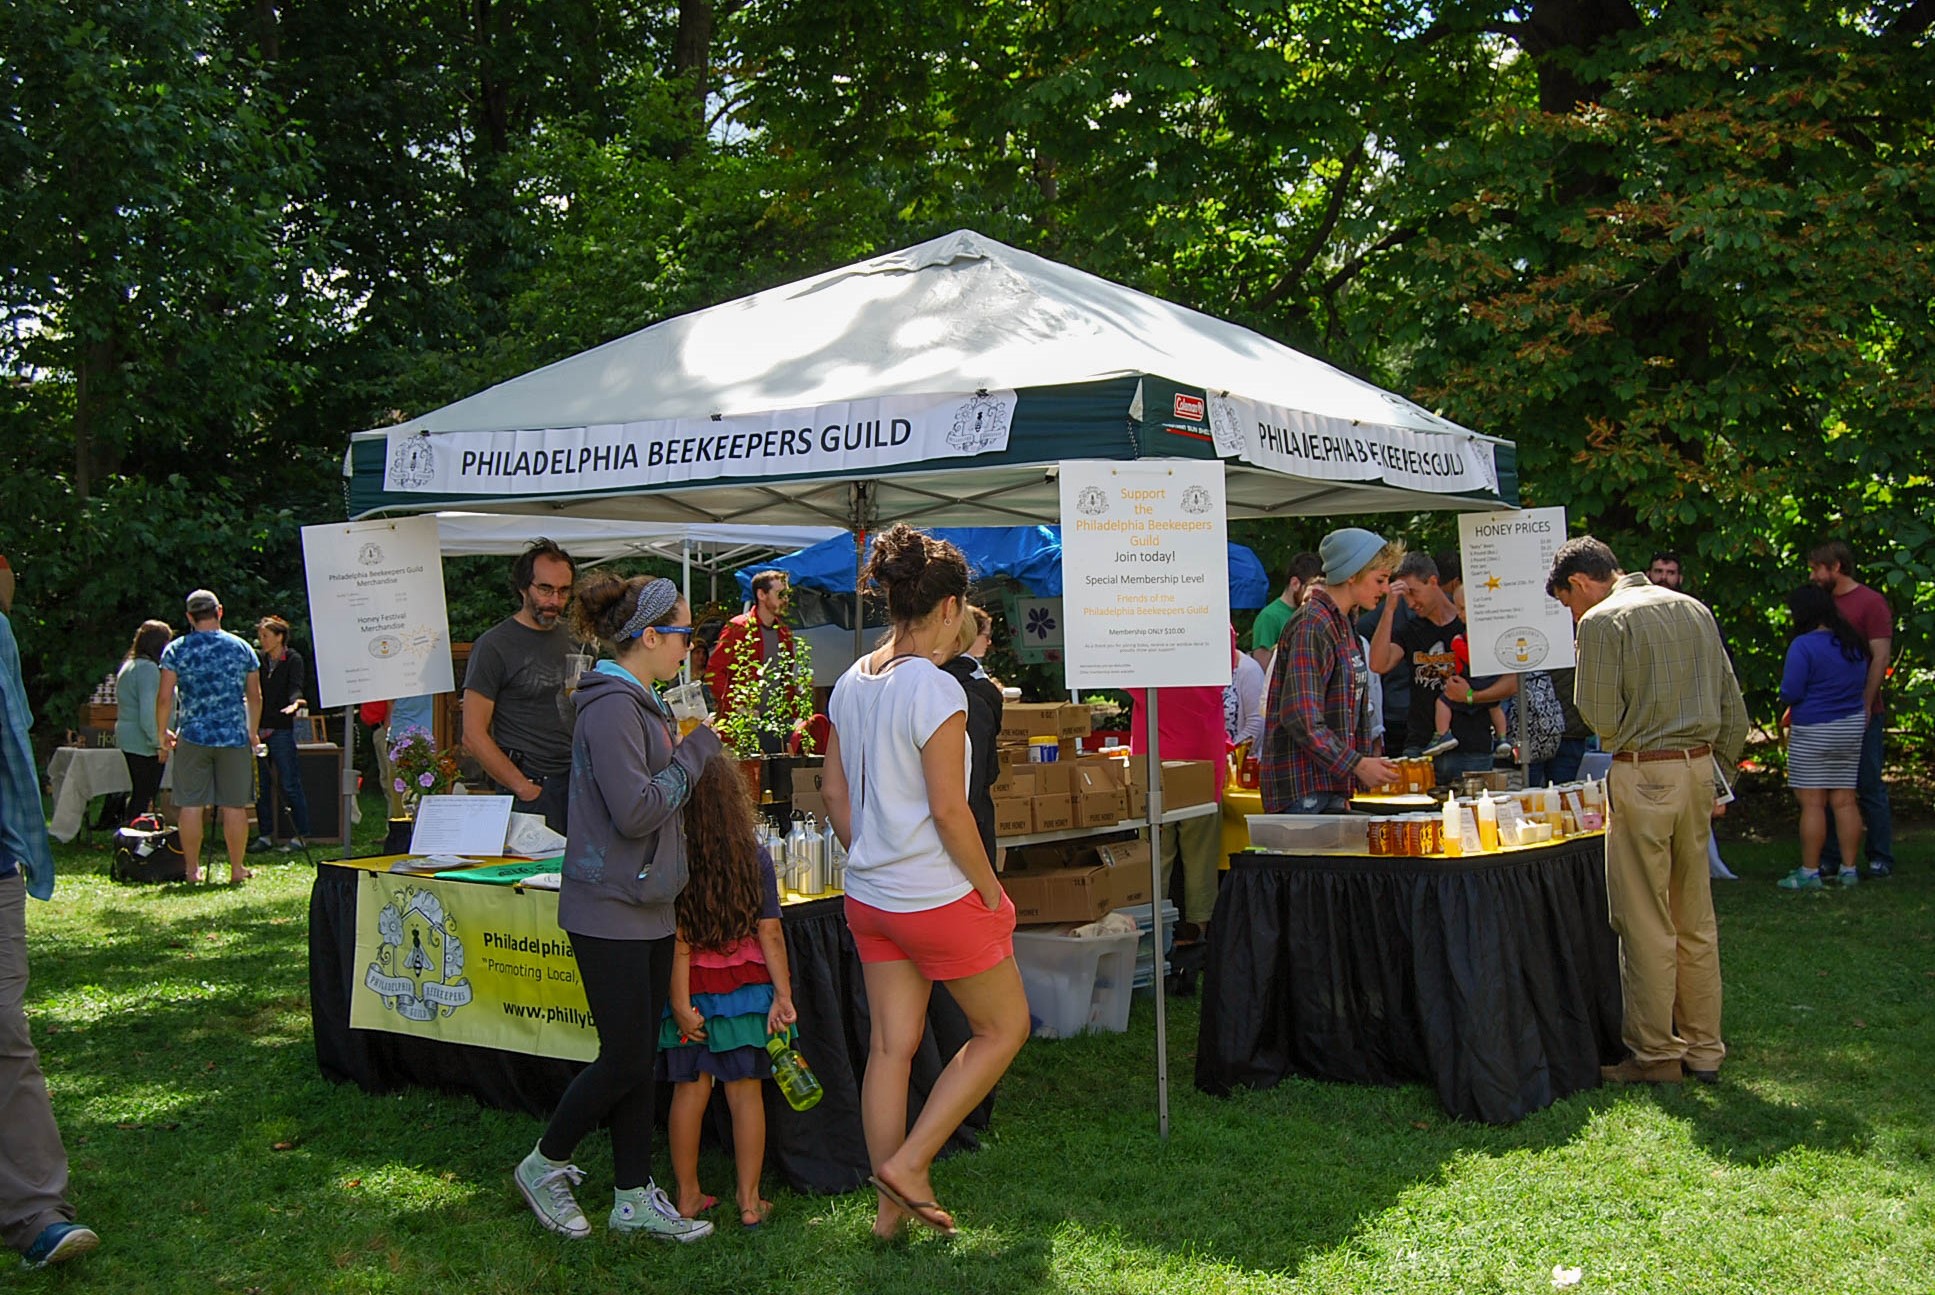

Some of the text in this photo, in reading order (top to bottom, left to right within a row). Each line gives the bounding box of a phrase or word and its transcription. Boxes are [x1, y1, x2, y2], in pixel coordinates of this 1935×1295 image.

[461, 417, 912, 477] PHILADELPHIA BEEKEEPERS GUILD
[1258, 421, 1464, 477] PHILADEPHIA BEKEEERS GULD
[1120, 487, 1166, 501] Support
[1134, 503, 1153, 515] the
[1076, 519, 1213, 533] Philadelphia Beekeepers
[1475, 520, 1551, 538] HONEY PRICES
[1130, 535, 1160, 547] Guild
[1114, 550, 1176, 565] Join today!
[329, 566, 424, 581] Philadelphia Beekeepers Guild
[1085, 573, 1205, 586] Special Membership Level
[356, 578, 398, 587] Merchandise
[1117, 593, 1175, 603] Friends of the
[358, 612, 407, 624] Honey Festival
[1083, 605, 1209, 617] Philadelphia Beekeepers Guild
[361, 622, 405, 632] Merchandise
[1109, 628, 1147, 636] Membership
[1164, 627, 1186, 635] $10.00
[483, 931, 575, 958] Philadelphia
[546, 964, 579, 986] Local,
[503, 1001, 596, 1029] www.phillyb
